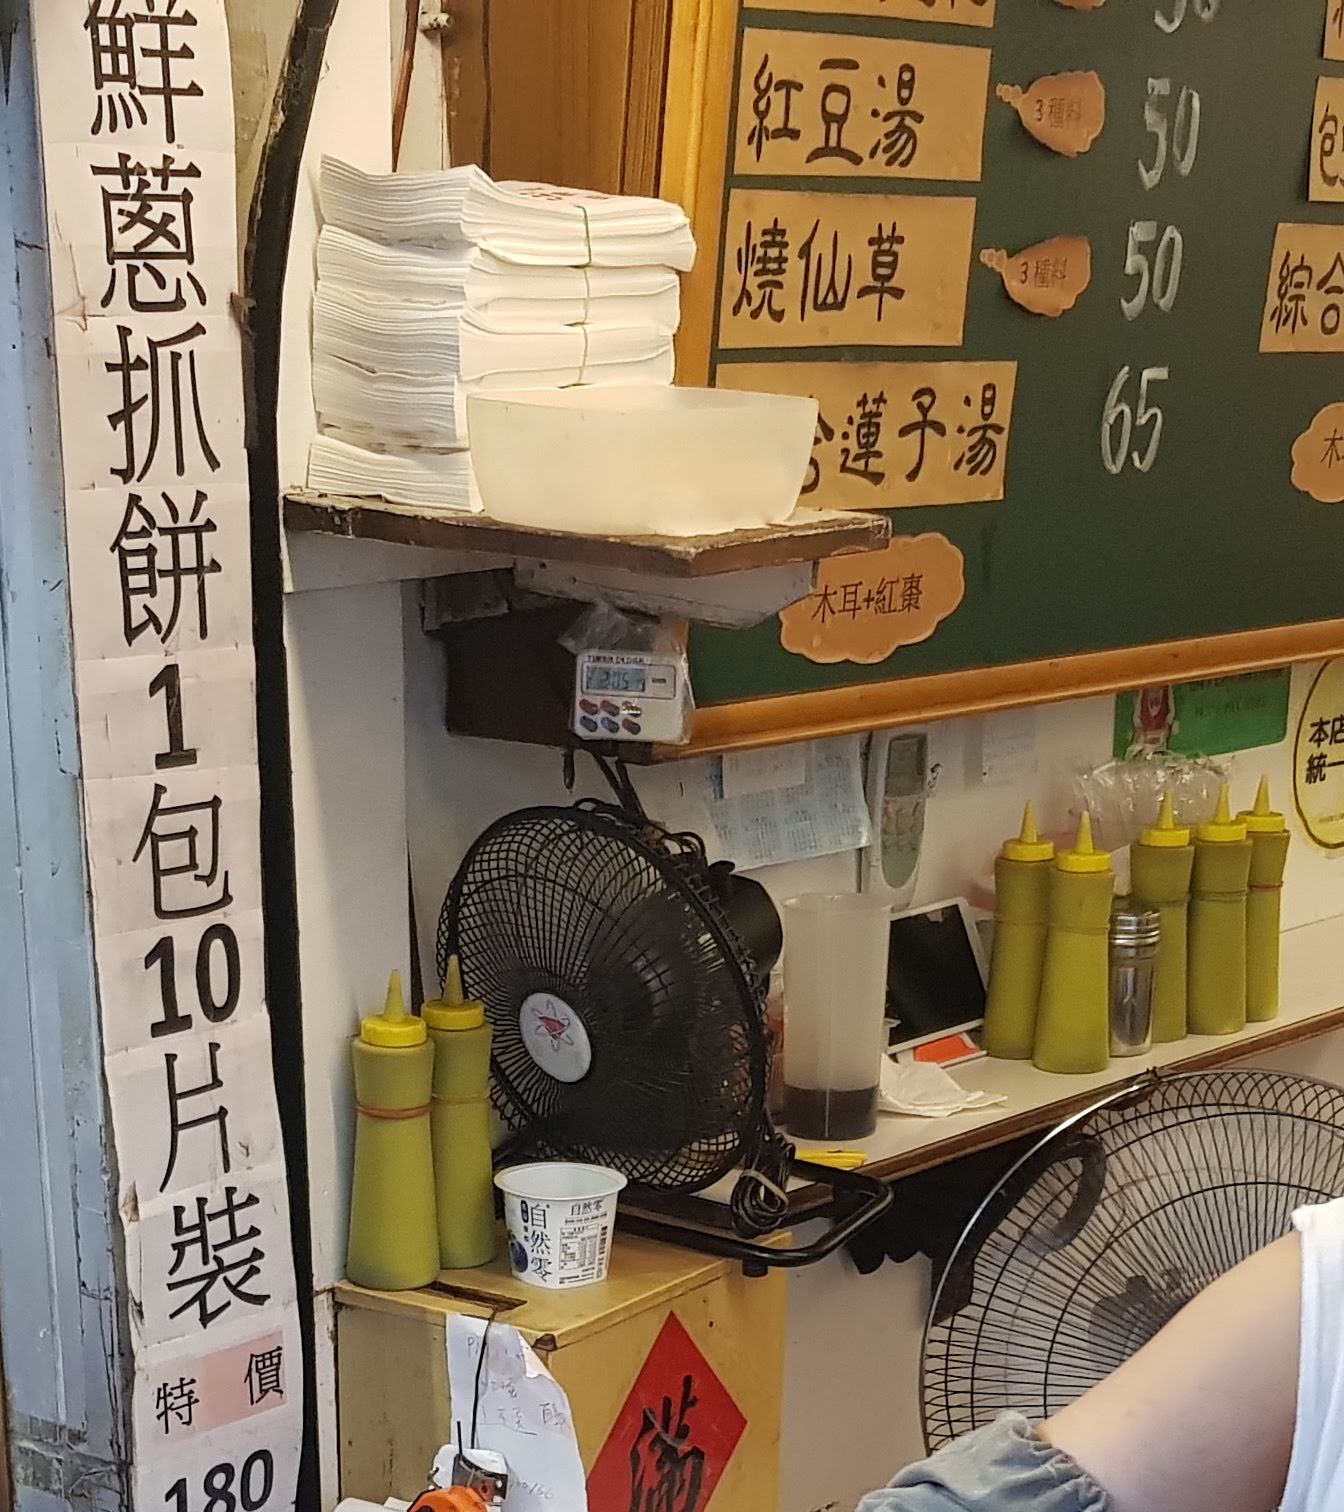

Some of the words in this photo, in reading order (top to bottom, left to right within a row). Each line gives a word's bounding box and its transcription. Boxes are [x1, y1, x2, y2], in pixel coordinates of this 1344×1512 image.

[747, 54, 924, 168] 紅豆湯
[1138, 77, 1200, 190] 50
[732, 217, 906, 323] 燒仙草
[1120, 221, 1183, 321] 50
[1099, 365, 1170, 474] 65
